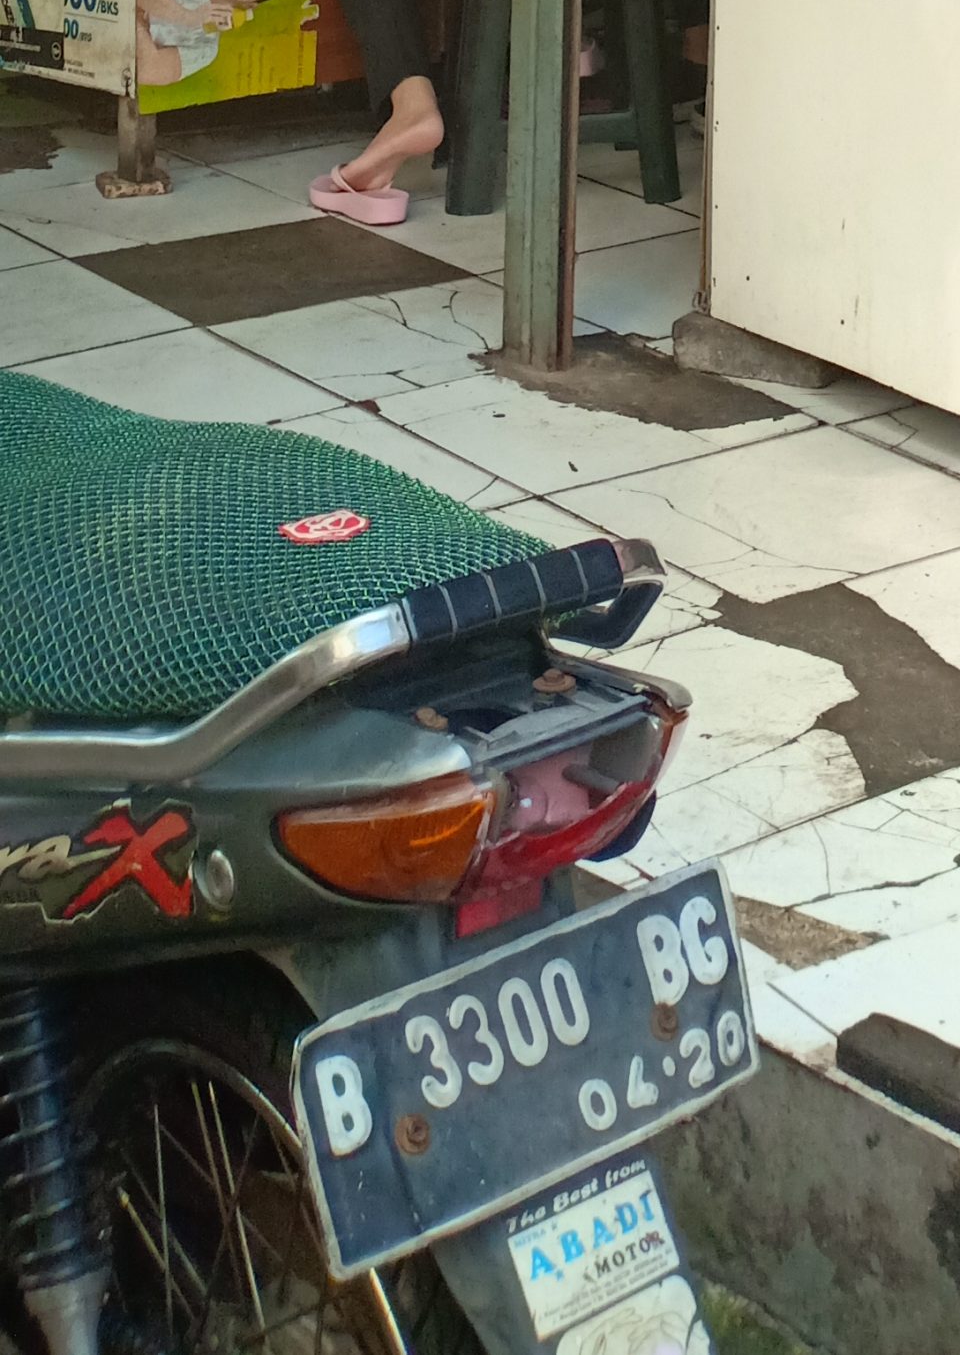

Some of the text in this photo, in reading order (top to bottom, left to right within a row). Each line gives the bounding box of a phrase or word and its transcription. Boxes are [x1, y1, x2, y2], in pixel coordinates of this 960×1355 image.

[315, 1054, 374, 1158] B
[404, 957, 590, 1109] 3300
[506, 1159, 648, 1234] The Best from
[530, 1188, 657, 1282] ABADI
[593, 1231, 666, 1279] MOTOR
